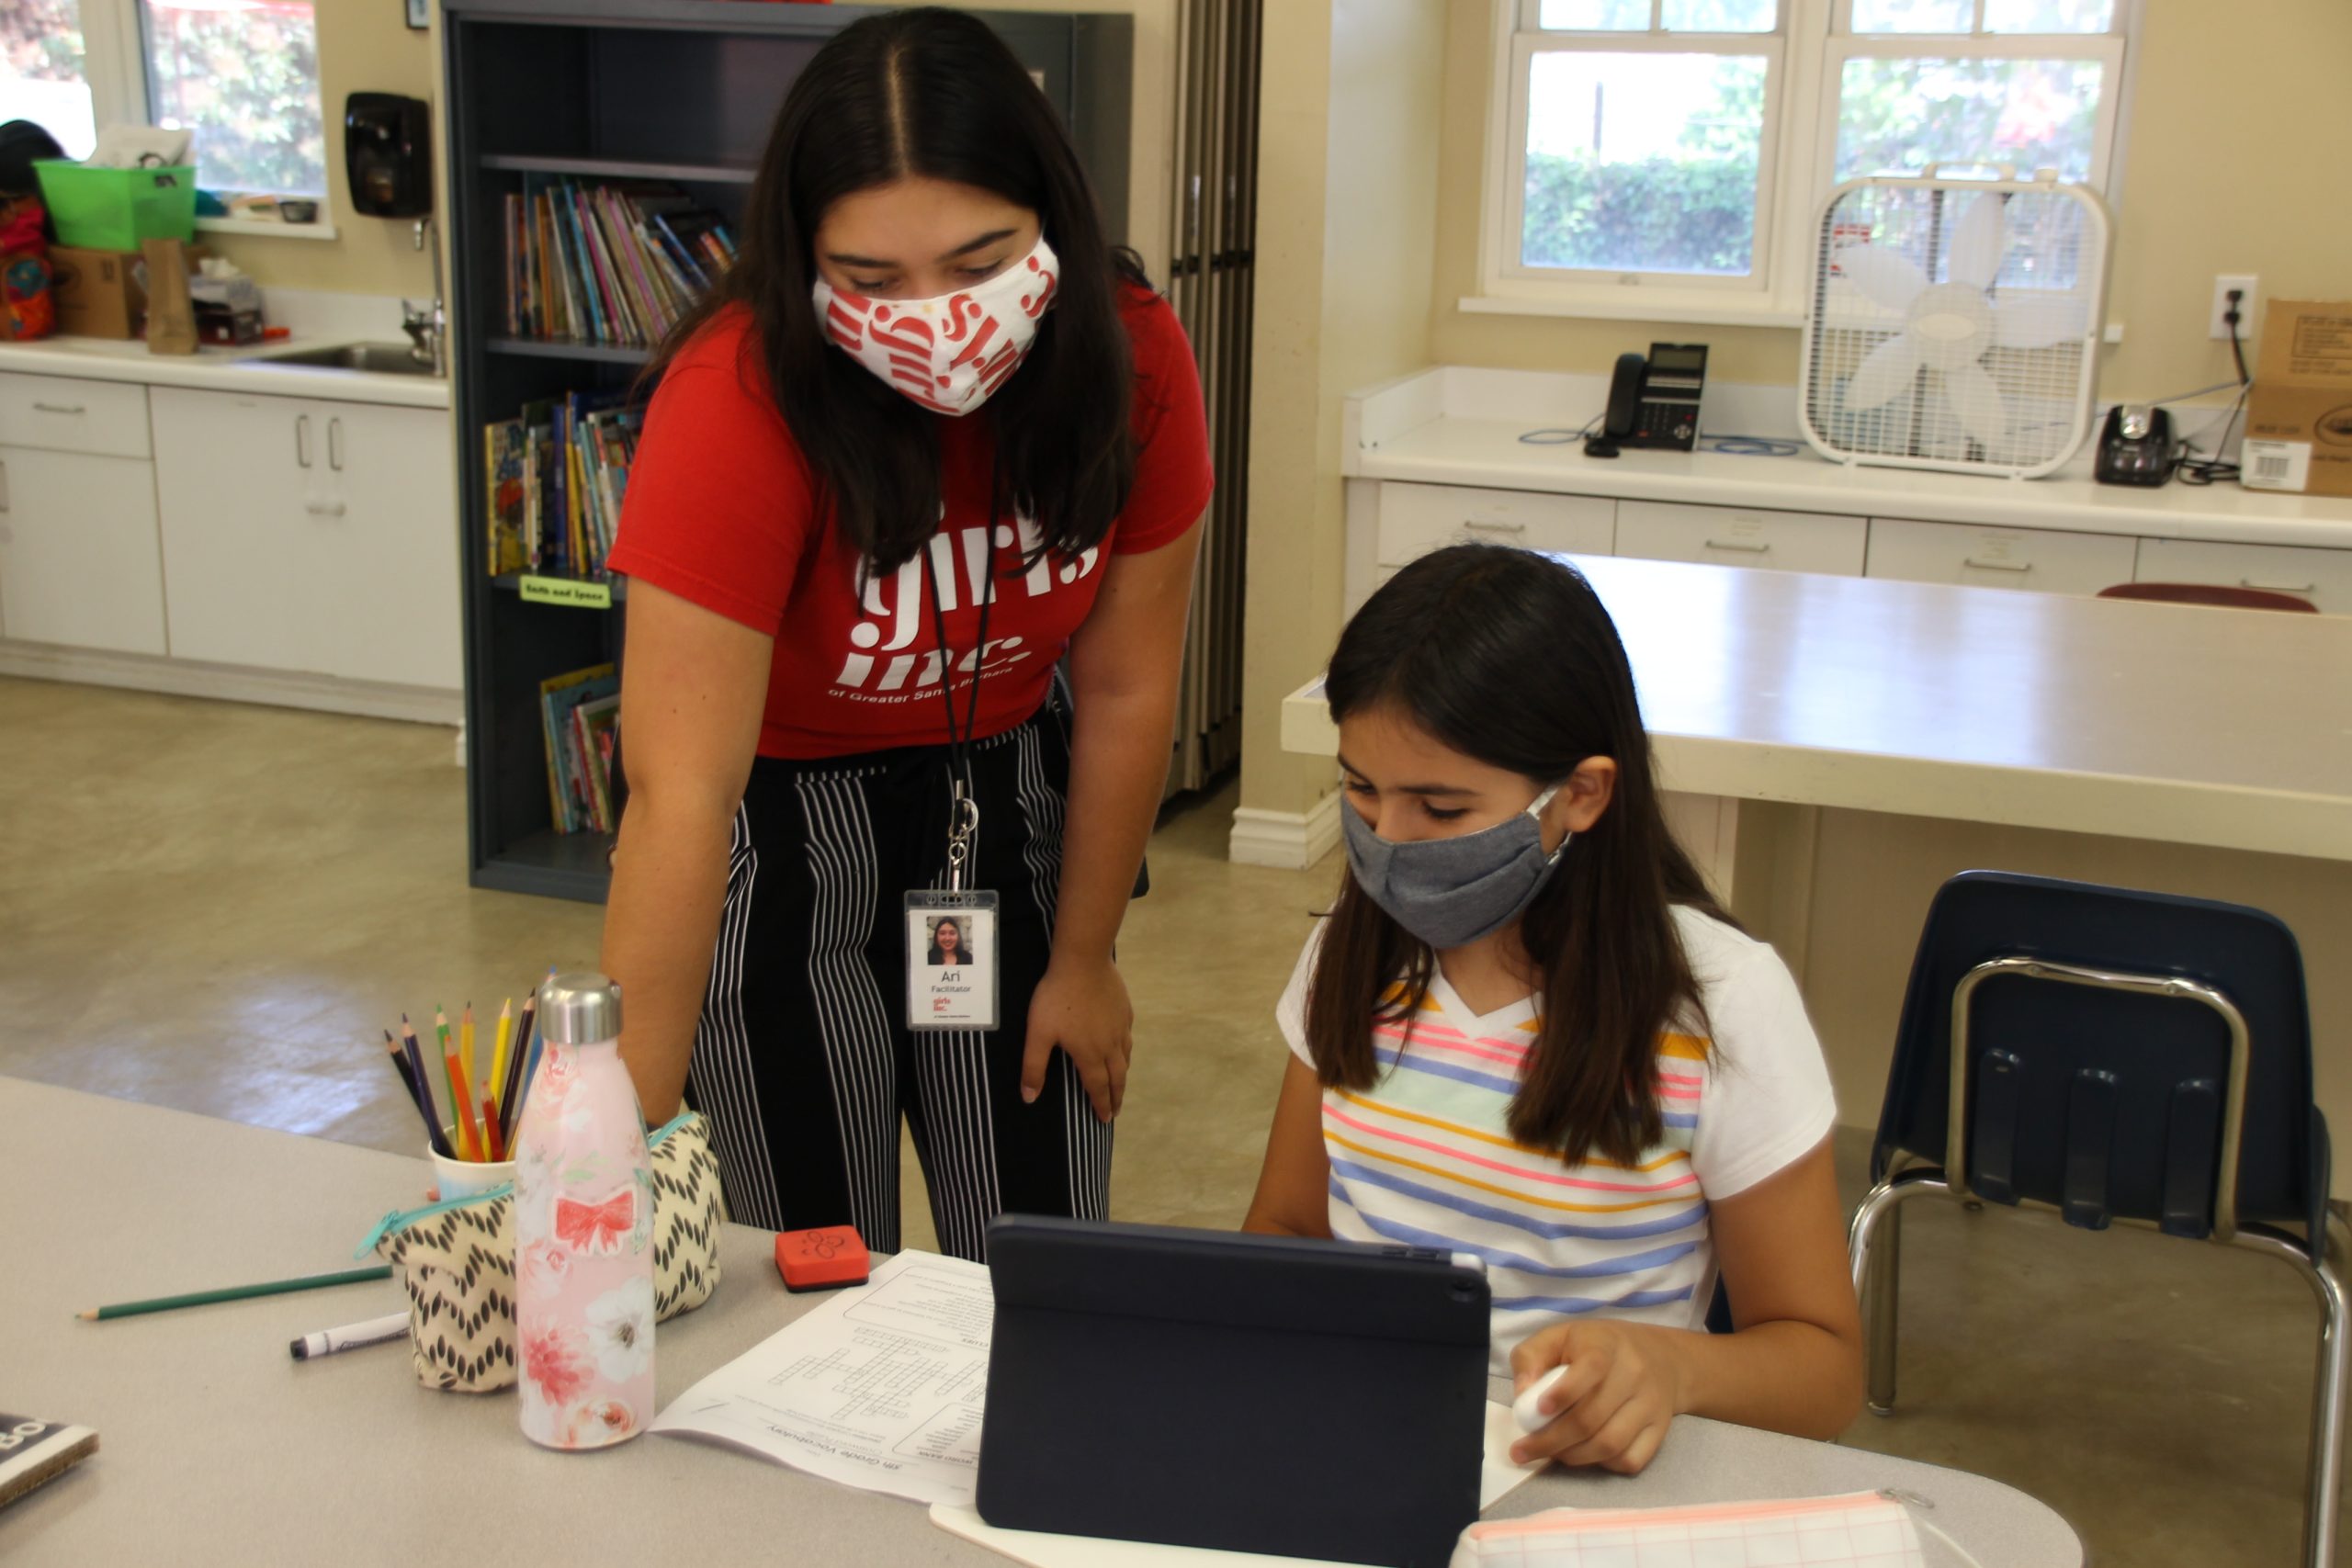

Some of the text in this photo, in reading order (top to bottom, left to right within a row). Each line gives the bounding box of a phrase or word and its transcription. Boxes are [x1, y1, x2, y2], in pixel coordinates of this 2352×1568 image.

[552, 588, 572, 597] and
[828, 689, 845, 697] of
[849, 693, 909, 704] Greater
[913, 682, 956, 702] Sana
[942, 971, 961, 982] Ari
[931, 985, 971, 993] Facilitator
[766, 1425, 837, 1454] Vocabulary
[840, 1450, 880, 1465] Grade
